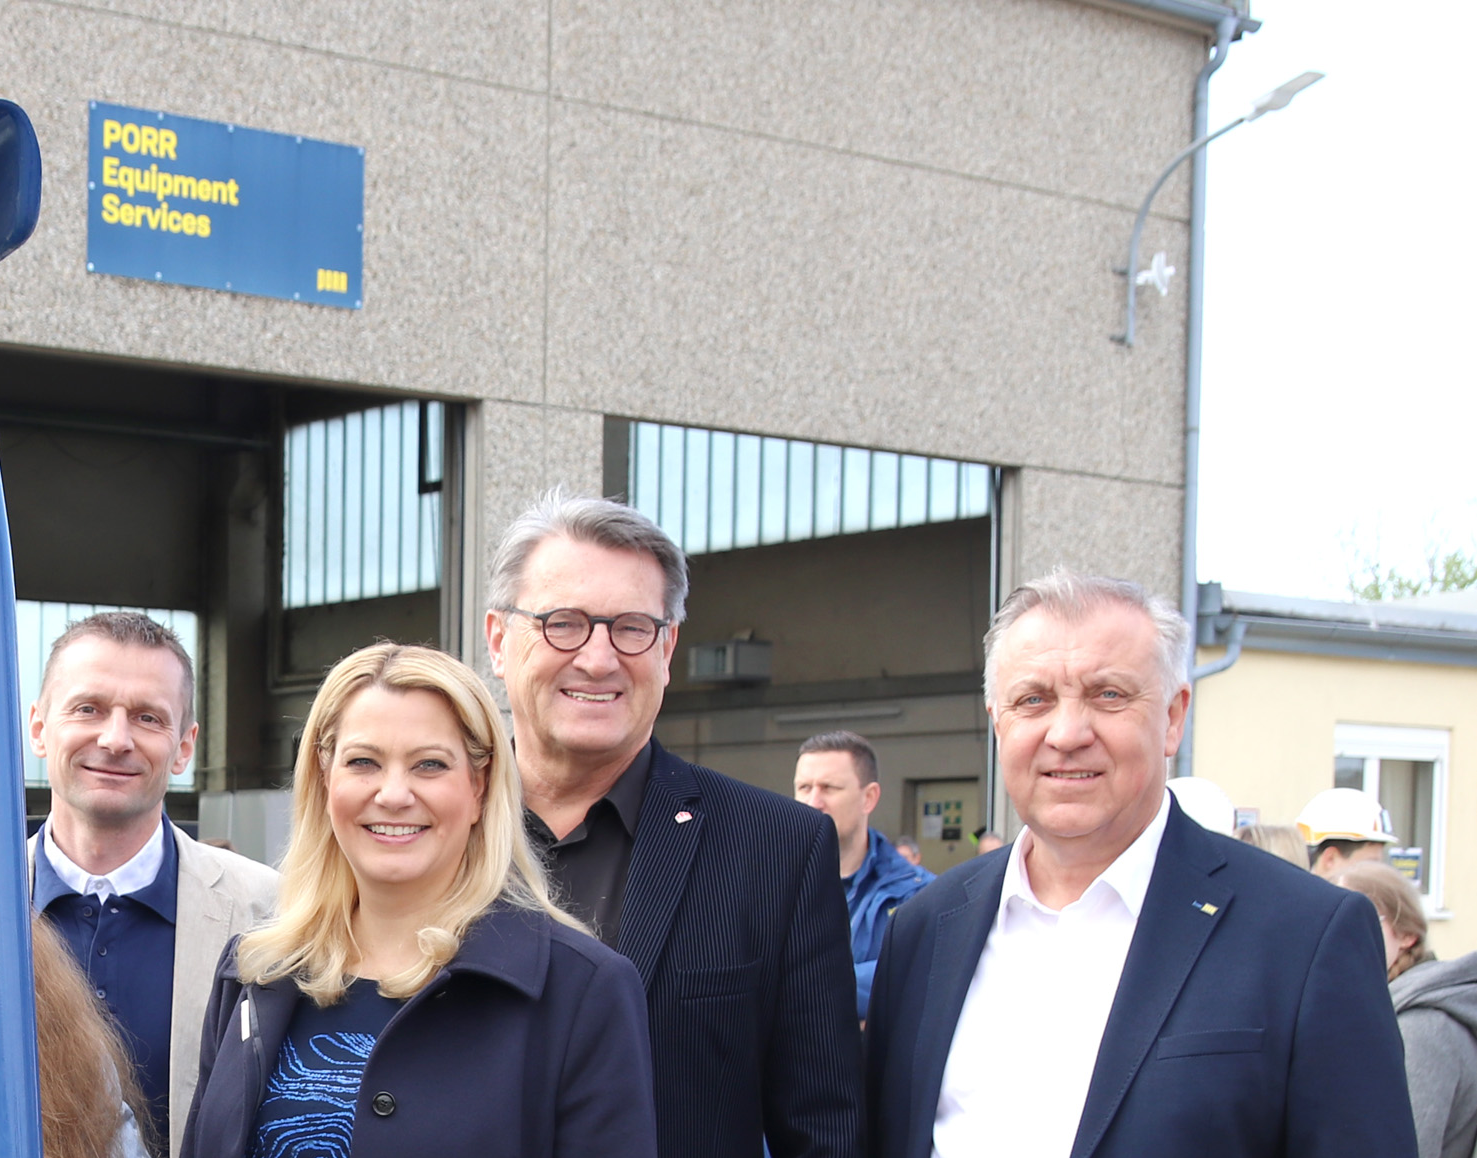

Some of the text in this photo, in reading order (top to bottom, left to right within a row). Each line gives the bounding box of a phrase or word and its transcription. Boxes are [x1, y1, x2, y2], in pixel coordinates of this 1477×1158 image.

[103, 119, 177, 160] PORR
[102, 156, 239, 206] Equipment
[101, 193, 211, 238] Services
